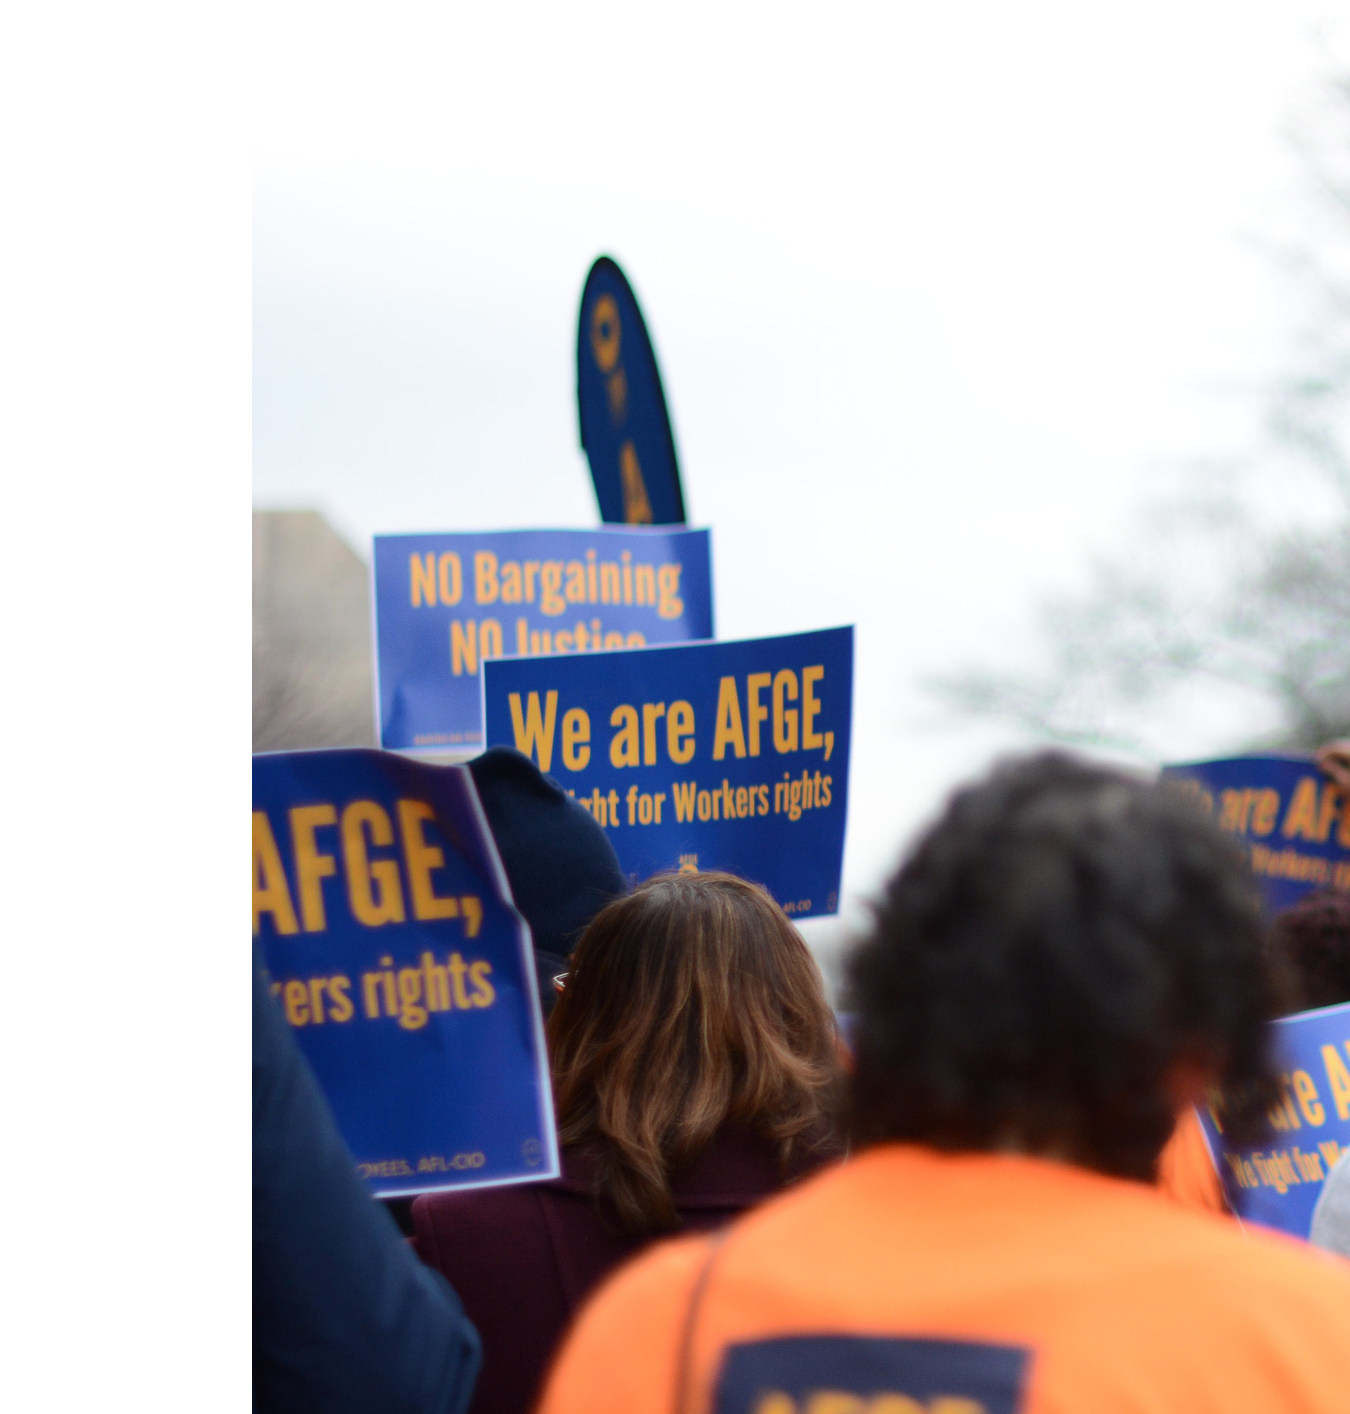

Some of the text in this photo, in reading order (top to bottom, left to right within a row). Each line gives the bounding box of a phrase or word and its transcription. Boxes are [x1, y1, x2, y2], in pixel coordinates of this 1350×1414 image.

[409, 548, 684, 620] NO Bargaining
[450, 617, 504, 677] NO
[509, 665, 835, 773] We are AFGE,
[626, 784, 666, 826] for
[673, 779, 769, 824] Workers
[775, 769, 833, 821] rights
[362, 951, 497, 1030] rights
[417, 1152, 486, 1173] AFL-CIO
[1251, 1150, 1301, 1194] fight
[1292, 1147, 1325, 1182] for
